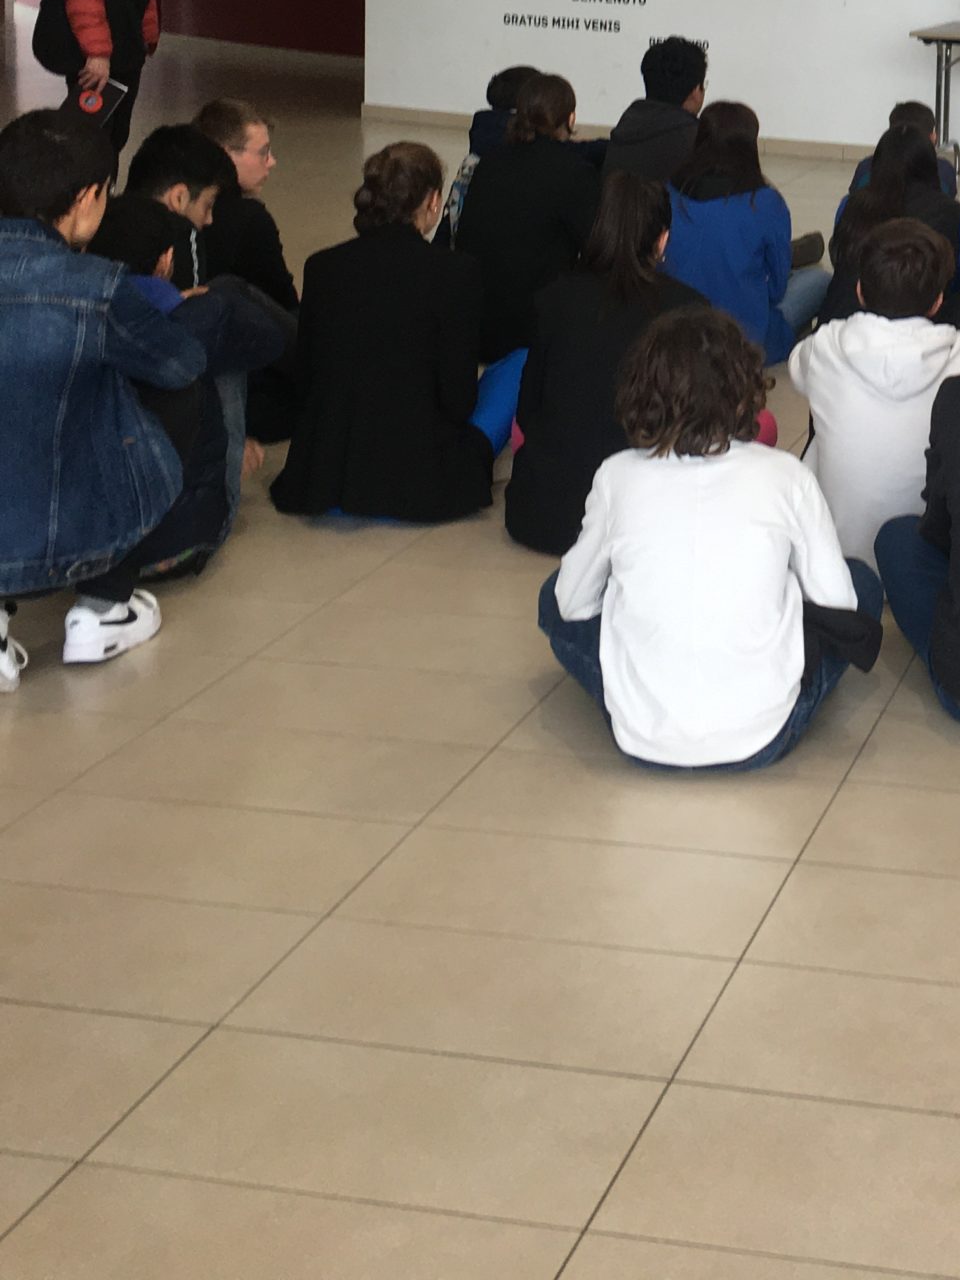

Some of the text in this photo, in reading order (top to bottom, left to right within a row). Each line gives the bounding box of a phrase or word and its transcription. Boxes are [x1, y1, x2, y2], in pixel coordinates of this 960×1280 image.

[504, 13, 620, 33] GRATUS MIHI VENIS
